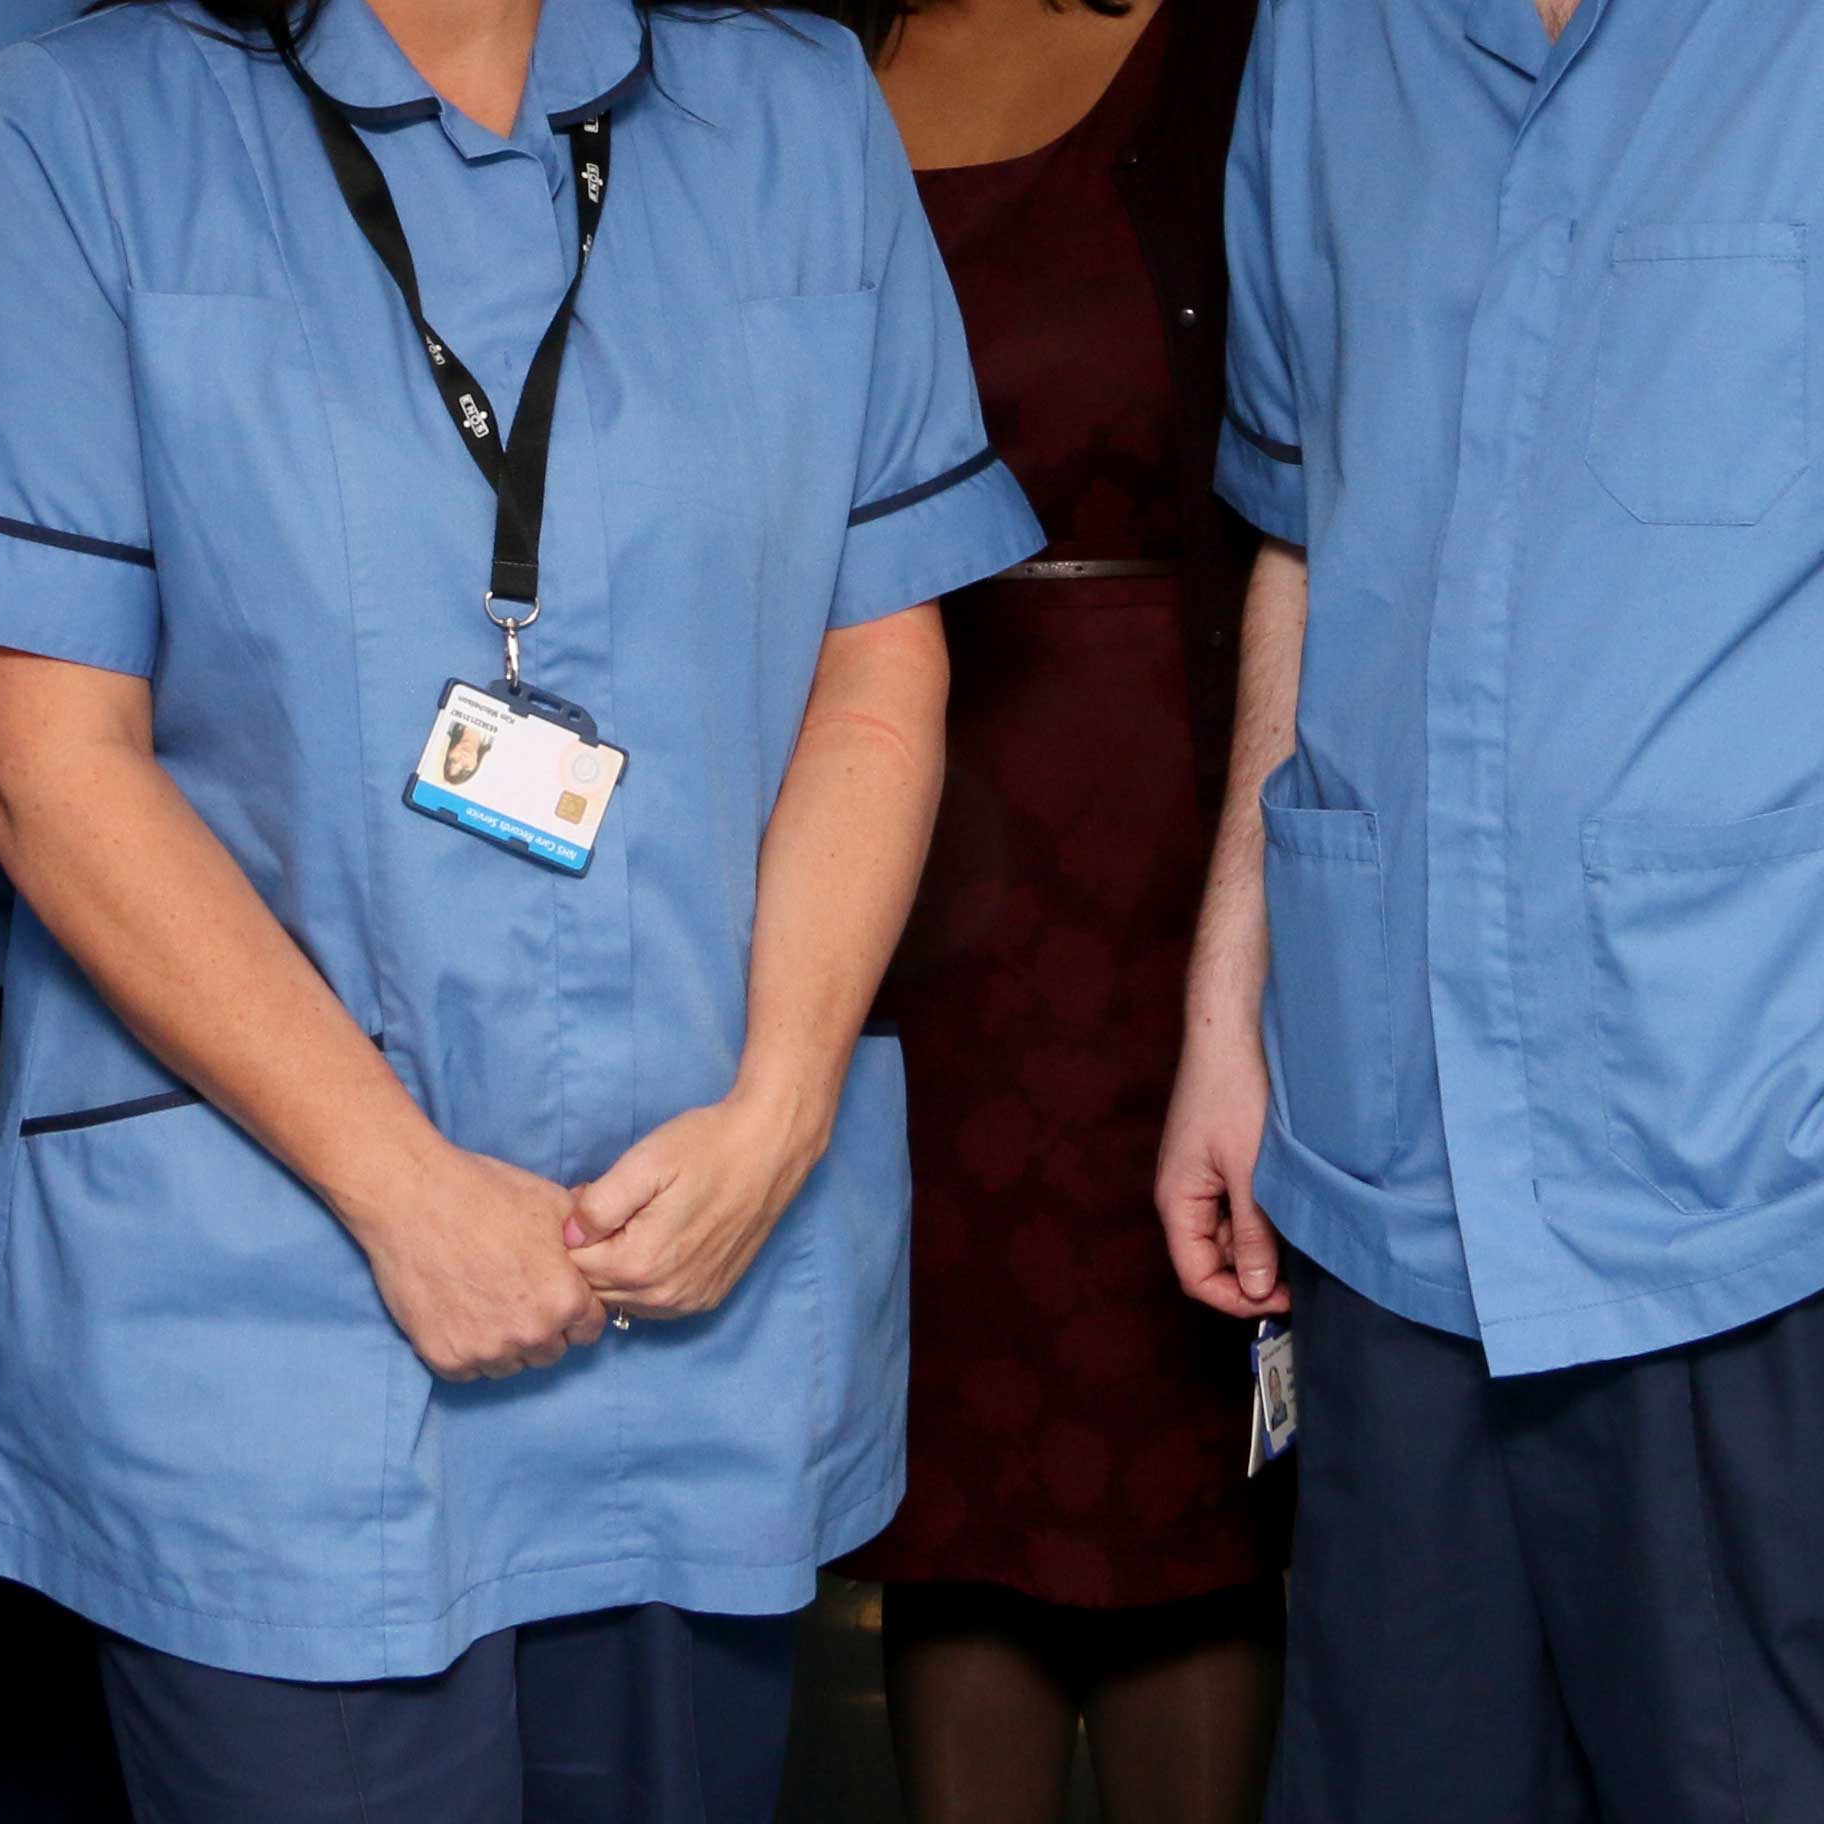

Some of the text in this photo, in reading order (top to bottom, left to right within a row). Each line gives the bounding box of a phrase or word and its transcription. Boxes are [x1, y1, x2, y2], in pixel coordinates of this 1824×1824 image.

[465, 807, 578, 861] NHS Care Records Service
